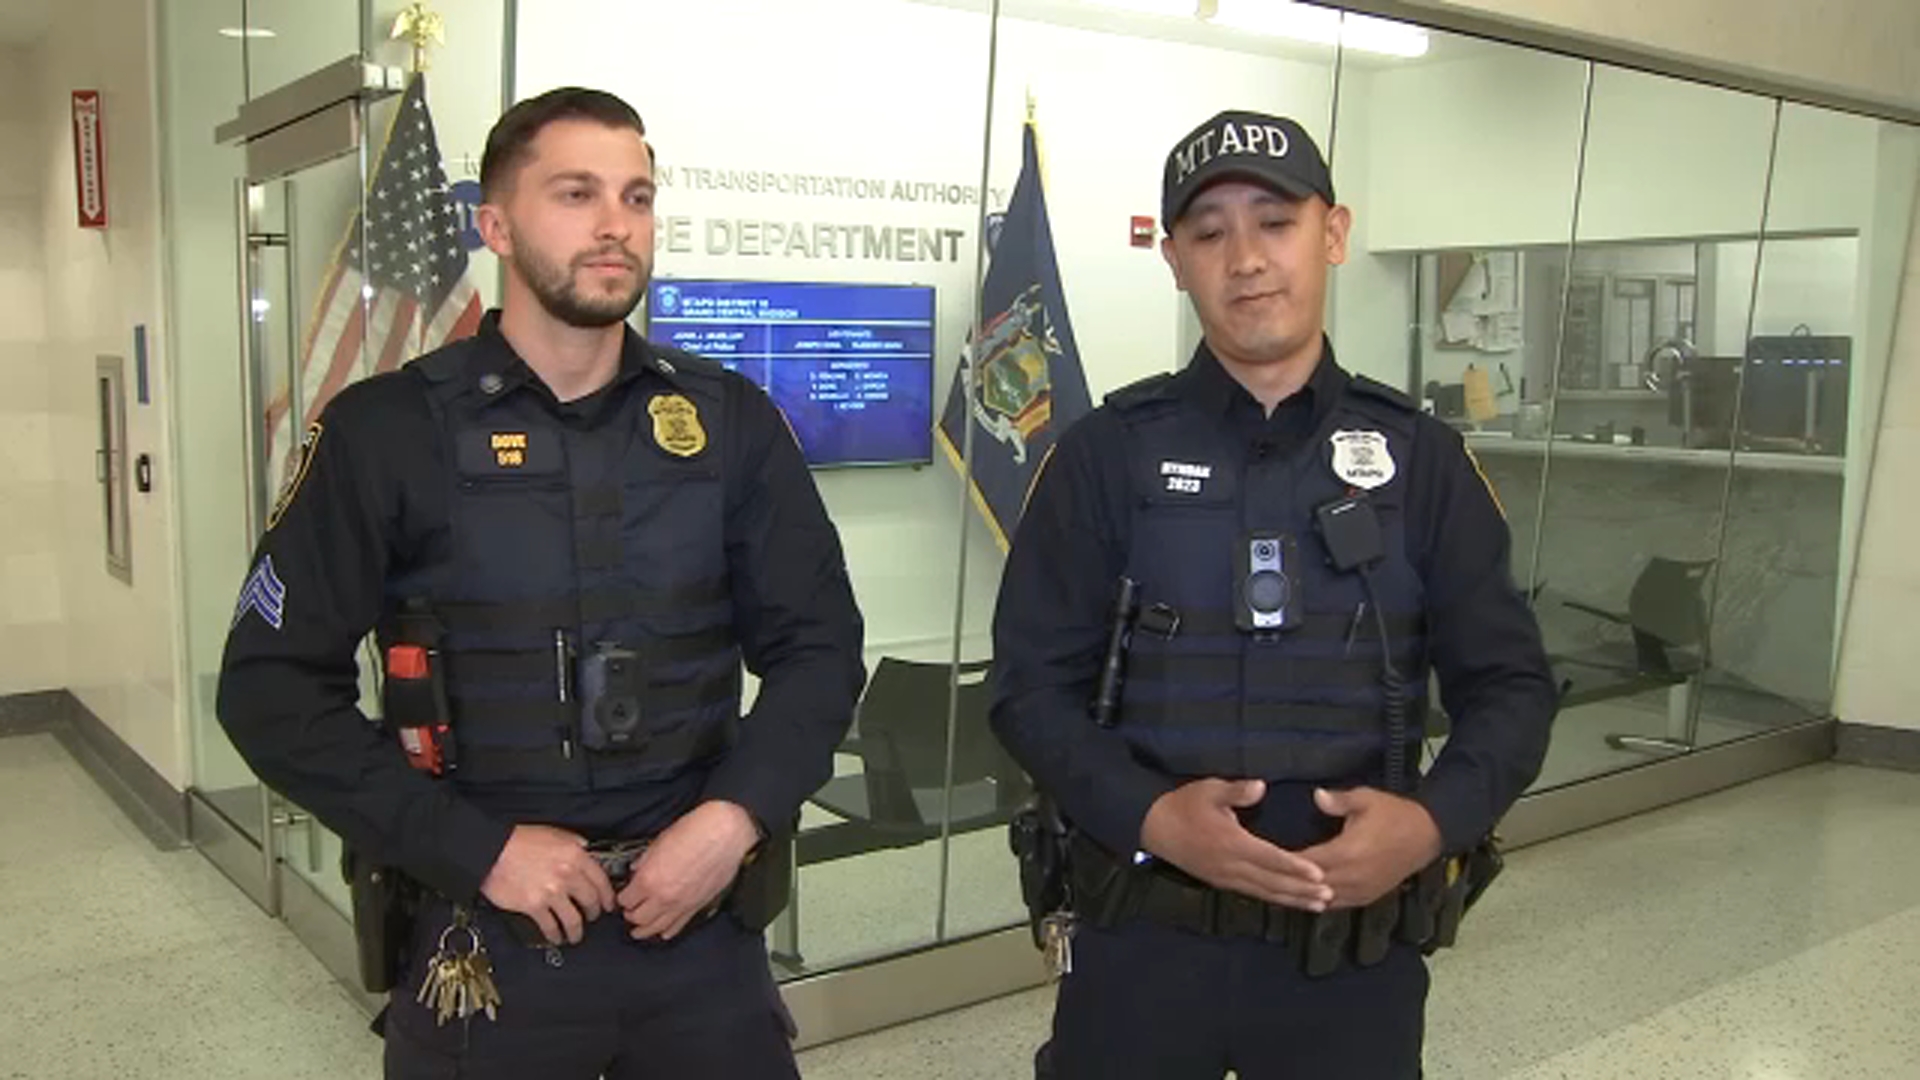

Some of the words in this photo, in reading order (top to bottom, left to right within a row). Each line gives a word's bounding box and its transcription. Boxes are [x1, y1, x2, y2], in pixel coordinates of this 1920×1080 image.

[681, 167, 886, 199] TRANSPORTATION
[890, 180, 1007, 208] AUTHORIY
[705, 218, 965, 262] DEPARTMENT
